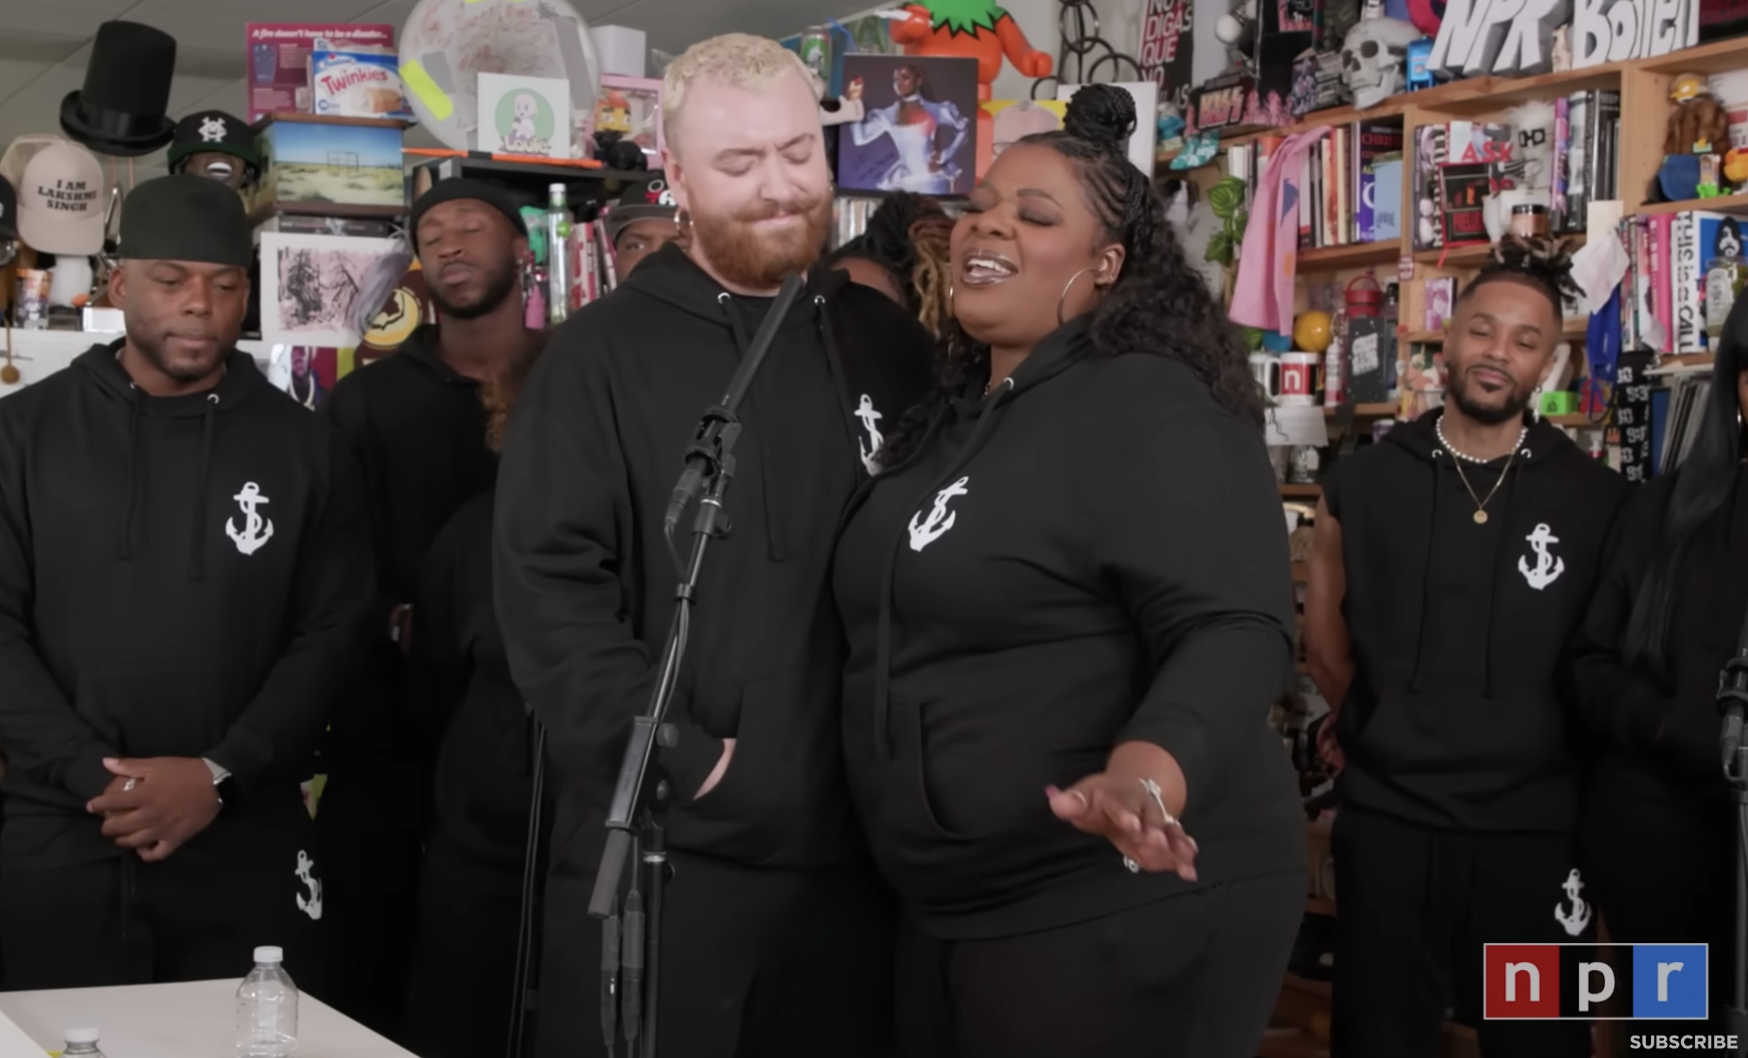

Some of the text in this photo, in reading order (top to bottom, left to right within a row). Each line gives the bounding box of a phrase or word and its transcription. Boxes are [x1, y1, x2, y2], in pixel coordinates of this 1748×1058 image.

[260, 28, 274, 40] fire
[275, 28, 303, 38] doesn't
[1145, 6, 1193, 42] DIGAS
[1142, 36, 1178, 67] QUE
[320, 65, 388, 96] Twinkies
[1461, 140, 1514, 162] ASK
[38, 186, 97, 200] LAKSHMI
[65, 181, 86, 190] AM
[47, 199, 87, 211] SINGH
[1678, 211, 1693, 260] THIS
[1678, 304, 1694, 352] CALL
